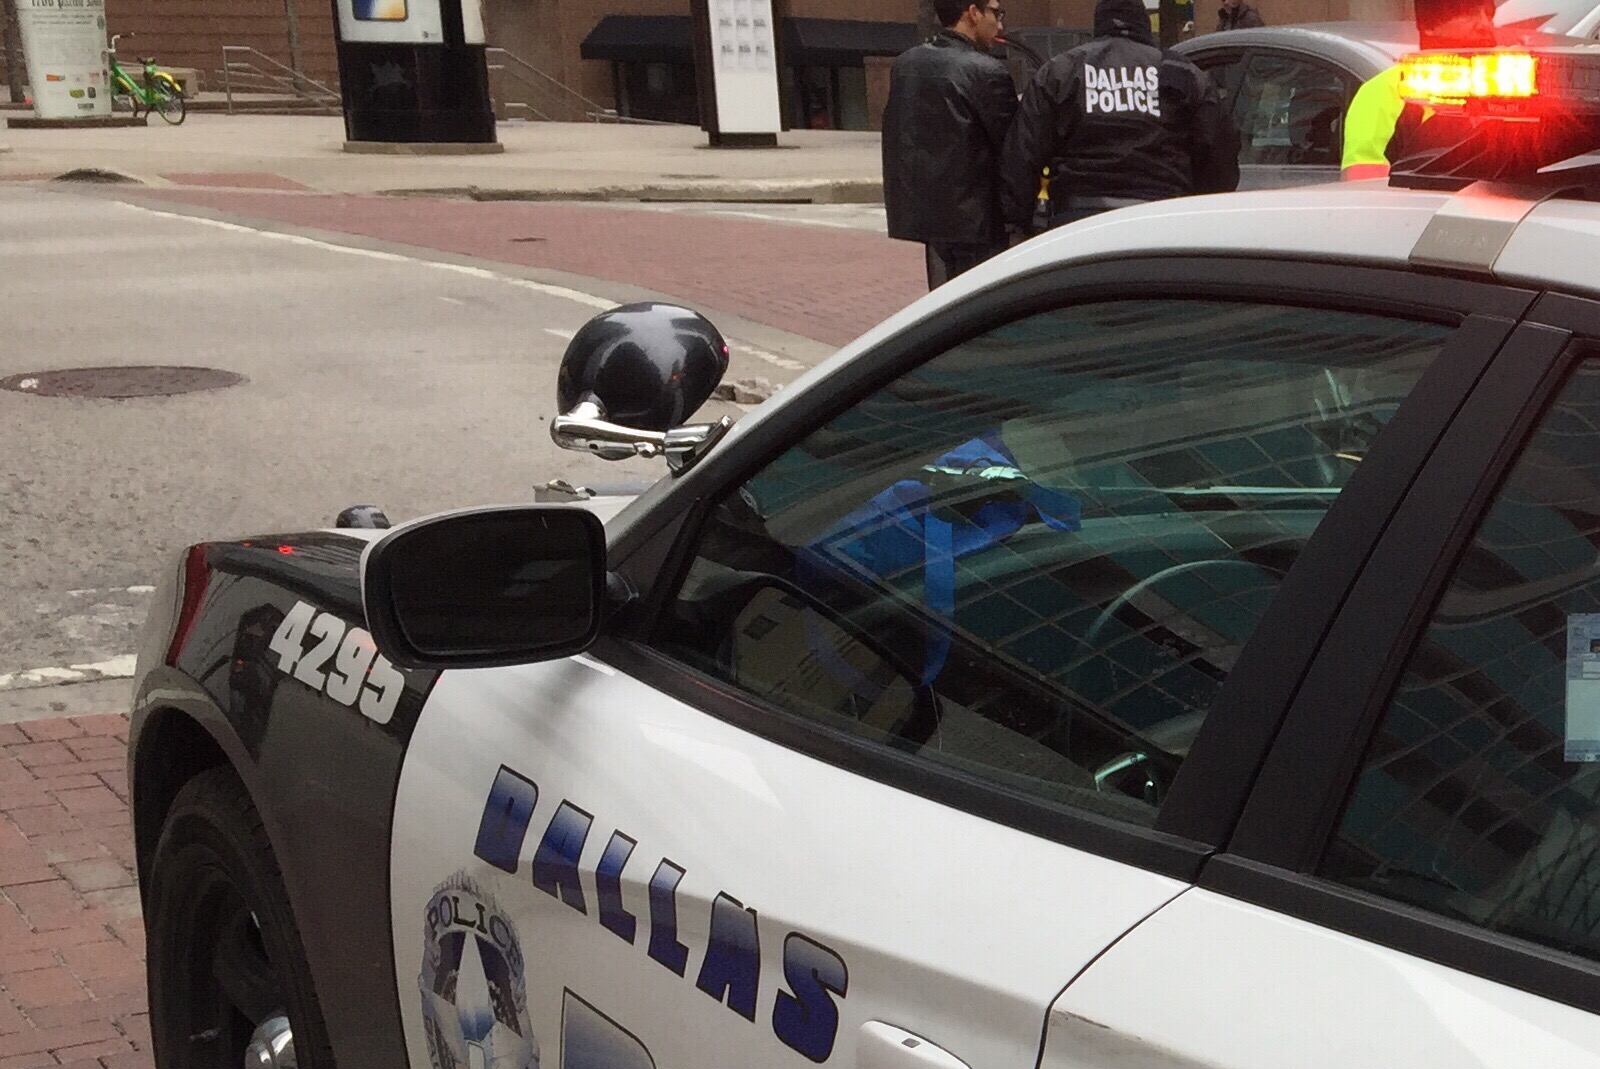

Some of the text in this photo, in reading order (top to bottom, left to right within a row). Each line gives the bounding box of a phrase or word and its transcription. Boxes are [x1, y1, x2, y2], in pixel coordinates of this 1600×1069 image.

[1085, 63, 1159, 91] DALLAS
[1085, 88, 1160, 117] POLICE
[269, 600, 405, 725] 4295
[474, 764, 848, 1063] DALLAS
